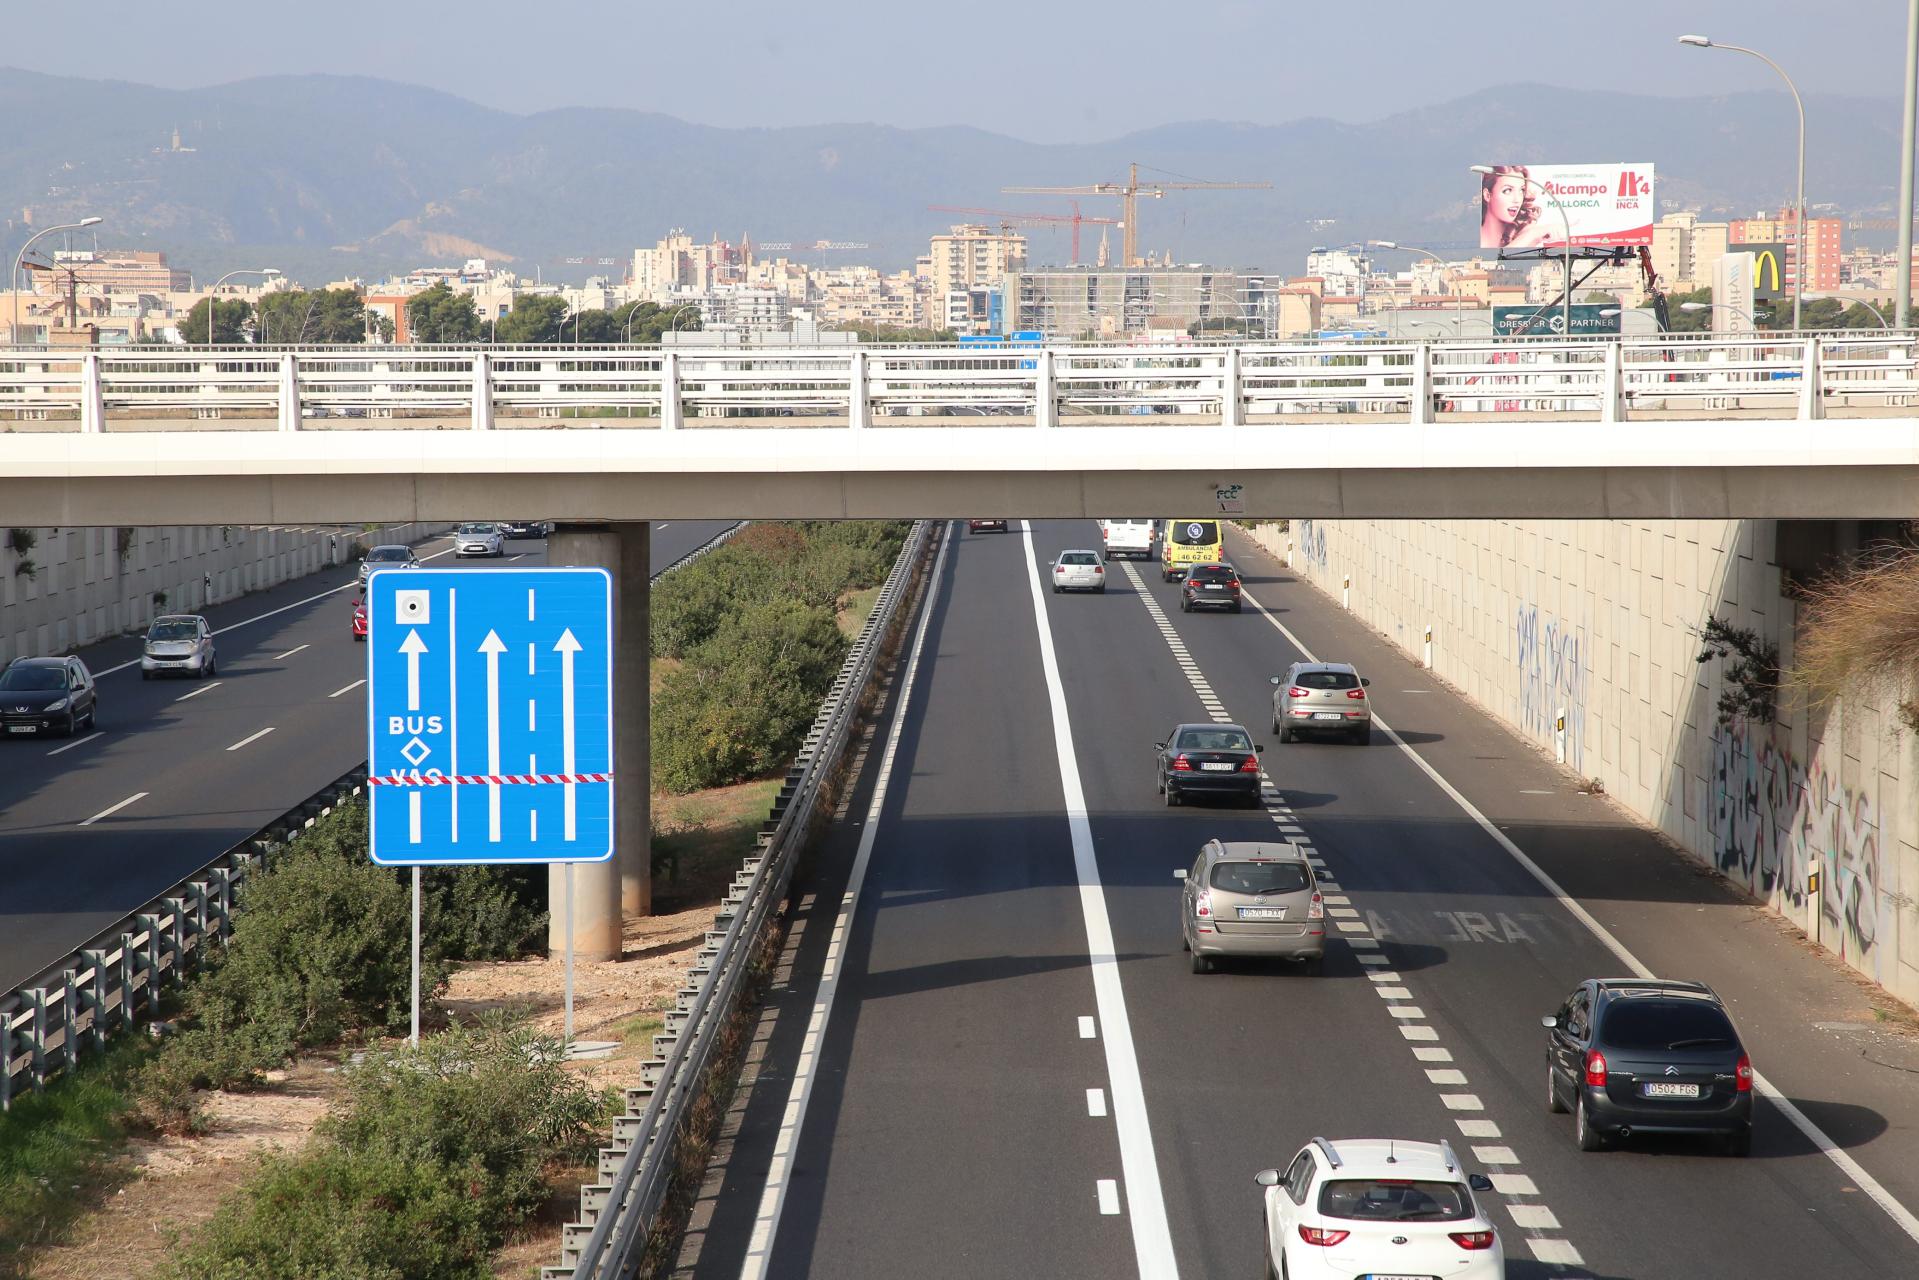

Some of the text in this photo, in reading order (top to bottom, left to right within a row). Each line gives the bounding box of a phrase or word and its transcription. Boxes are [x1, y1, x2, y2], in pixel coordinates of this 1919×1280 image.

[1541, 181, 1607, 196] Alcampo
[1640, 182, 1650, 194] 4
[1547, 199, 1600, 208] MALLORCA
[1616, 201, 1639, 209] INCA
[1499, 319, 1614, 328] DRESSER PARTNER
[1217, 490, 1237, 499] FCC
[389, 716, 443, 735] BUS
